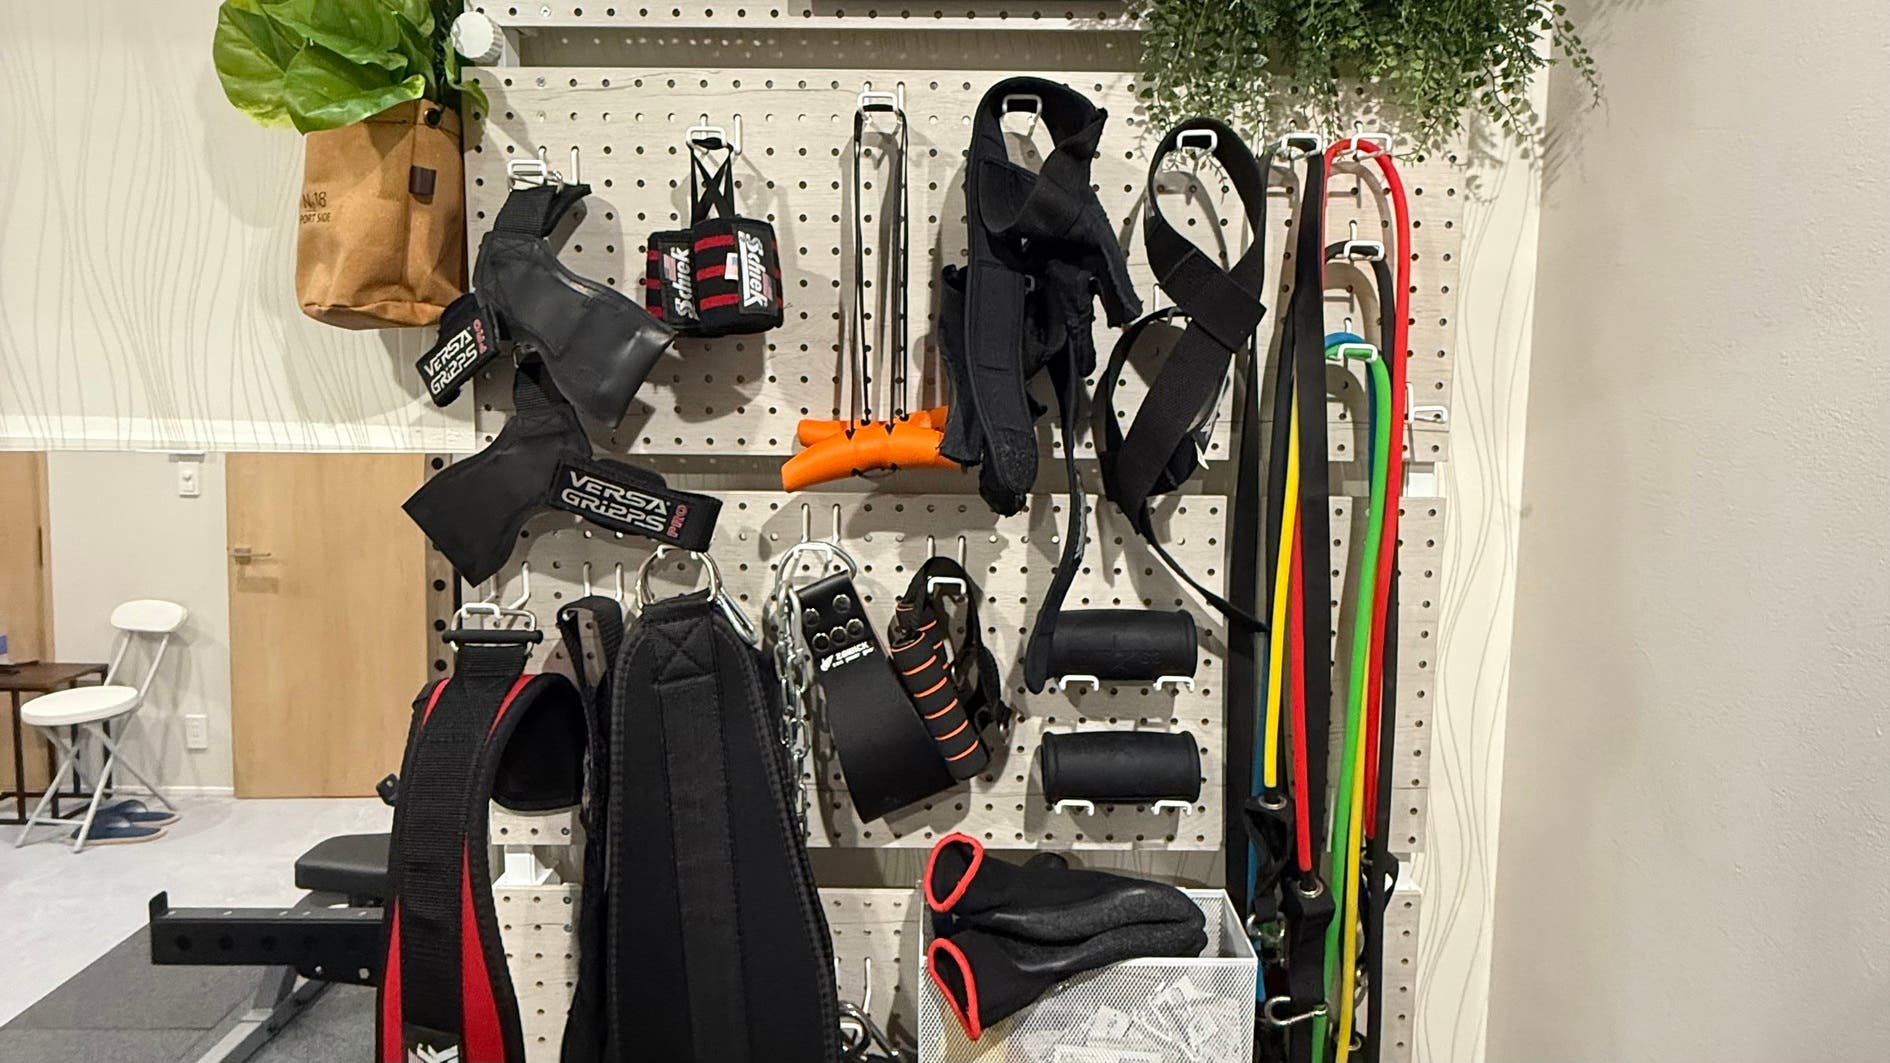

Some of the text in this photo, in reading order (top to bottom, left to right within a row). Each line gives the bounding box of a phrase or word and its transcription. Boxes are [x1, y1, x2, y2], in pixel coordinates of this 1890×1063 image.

[317, 212, 332, 223] SIDE
[423, 329, 473, 376] VERSA
[569, 470, 668, 516] VERSA
[667, 504, 688, 538] PRO
